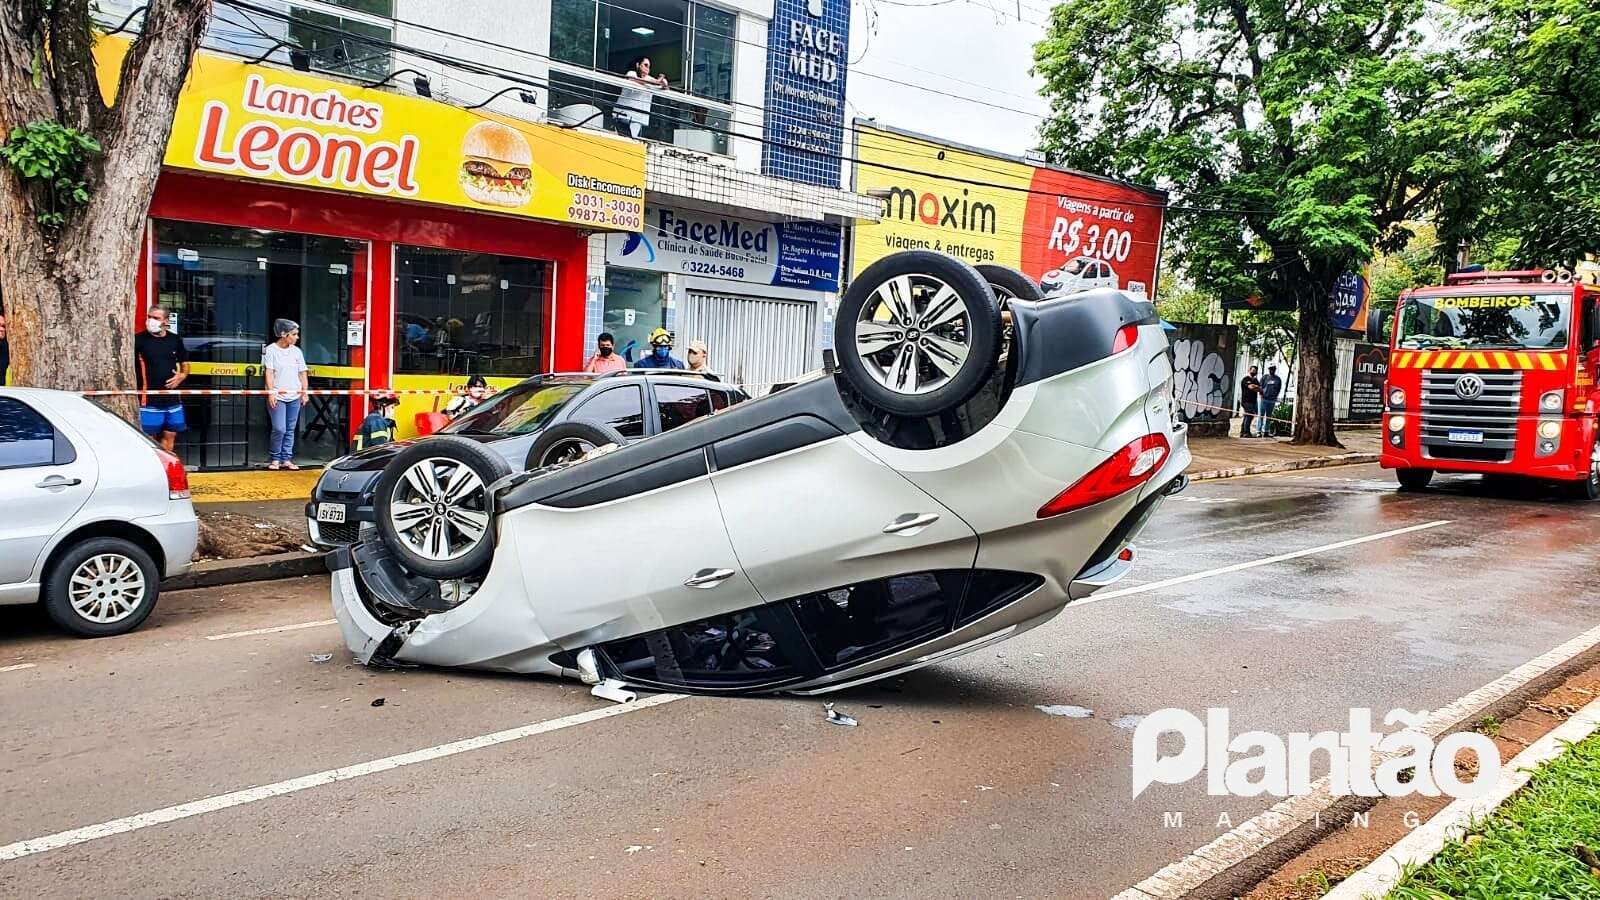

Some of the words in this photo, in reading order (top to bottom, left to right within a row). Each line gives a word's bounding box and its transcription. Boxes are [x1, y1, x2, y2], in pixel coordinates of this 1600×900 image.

[789, 19, 841, 56] FACE
[788, 49, 837, 83] MED
[246, 78, 380, 130] Lanches
[198, 105, 416, 192] Leonel
[568, 173, 590, 190] Disk
[590, 177, 643, 200] Encomenda
[567, 206, 641, 229] 99873-6090
[574, 192, 641, 215] 3031-3030
[881, 186, 996, 235] maxim
[1057, 195, 1092, 215] Viagens
[1092, 205, 1099, 215] a
[1099, 206, 1123, 223] partir
[1124, 208, 1135, 223] de
[657, 208, 769, 253] FaceMed
[1047, 216, 1084, 257] R$
[1082, 223, 1132, 263] 3,00
[657, 239, 687, 253] Clínica
[688, 244, 699, 255] de
[700, 245, 723, 259] Saúde
[885, 232, 930, 250] viagens
[946, 242, 995, 263] entregas
[690, 260, 745, 279] 3224-5468
[1434, 295, 1533, 309] BOMBEIROS
[210, 366, 239, 375] Leonel
